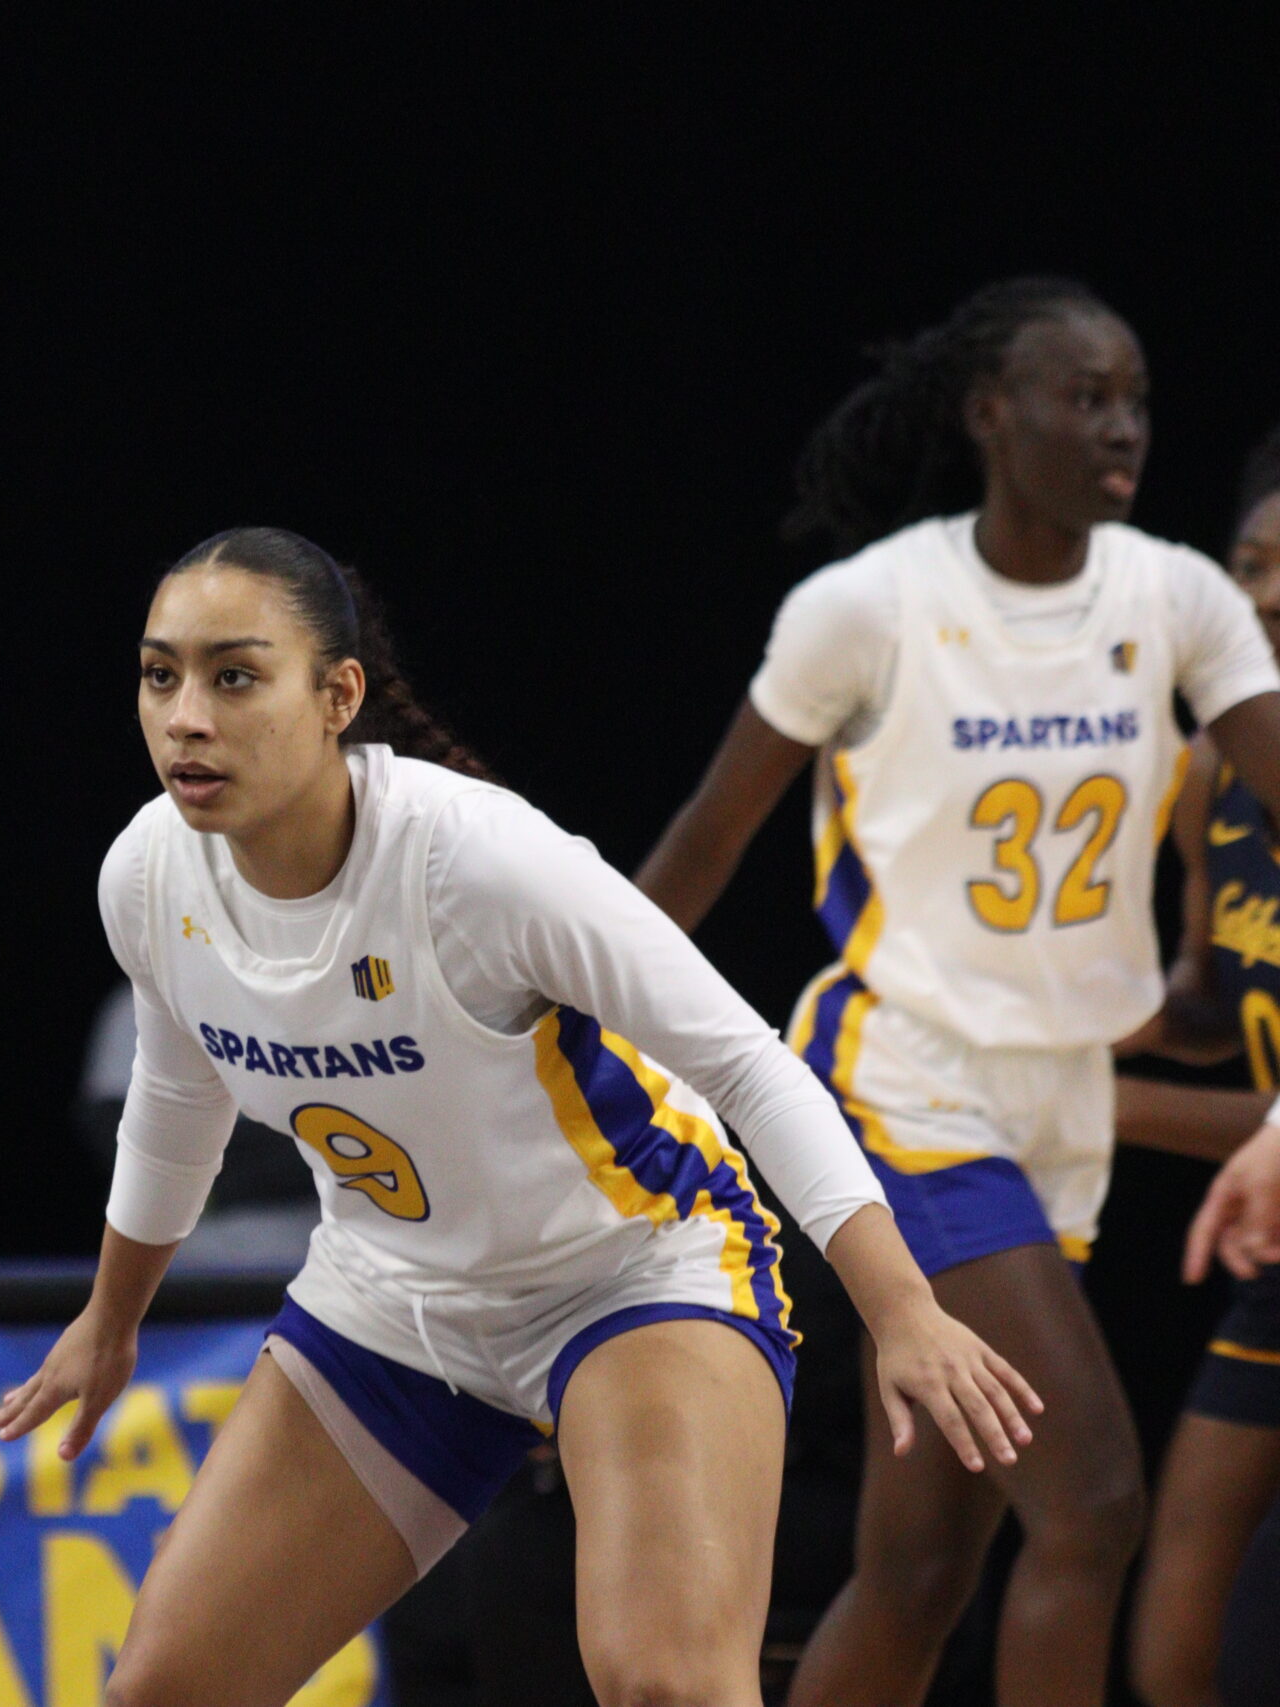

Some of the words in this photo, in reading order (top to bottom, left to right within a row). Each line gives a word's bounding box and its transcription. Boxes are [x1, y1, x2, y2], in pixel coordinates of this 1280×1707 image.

[967, 775, 1128, 934] 32
[199, 1022, 425, 1078] SPARTANS
[289, 1102, 431, 1222] 9
